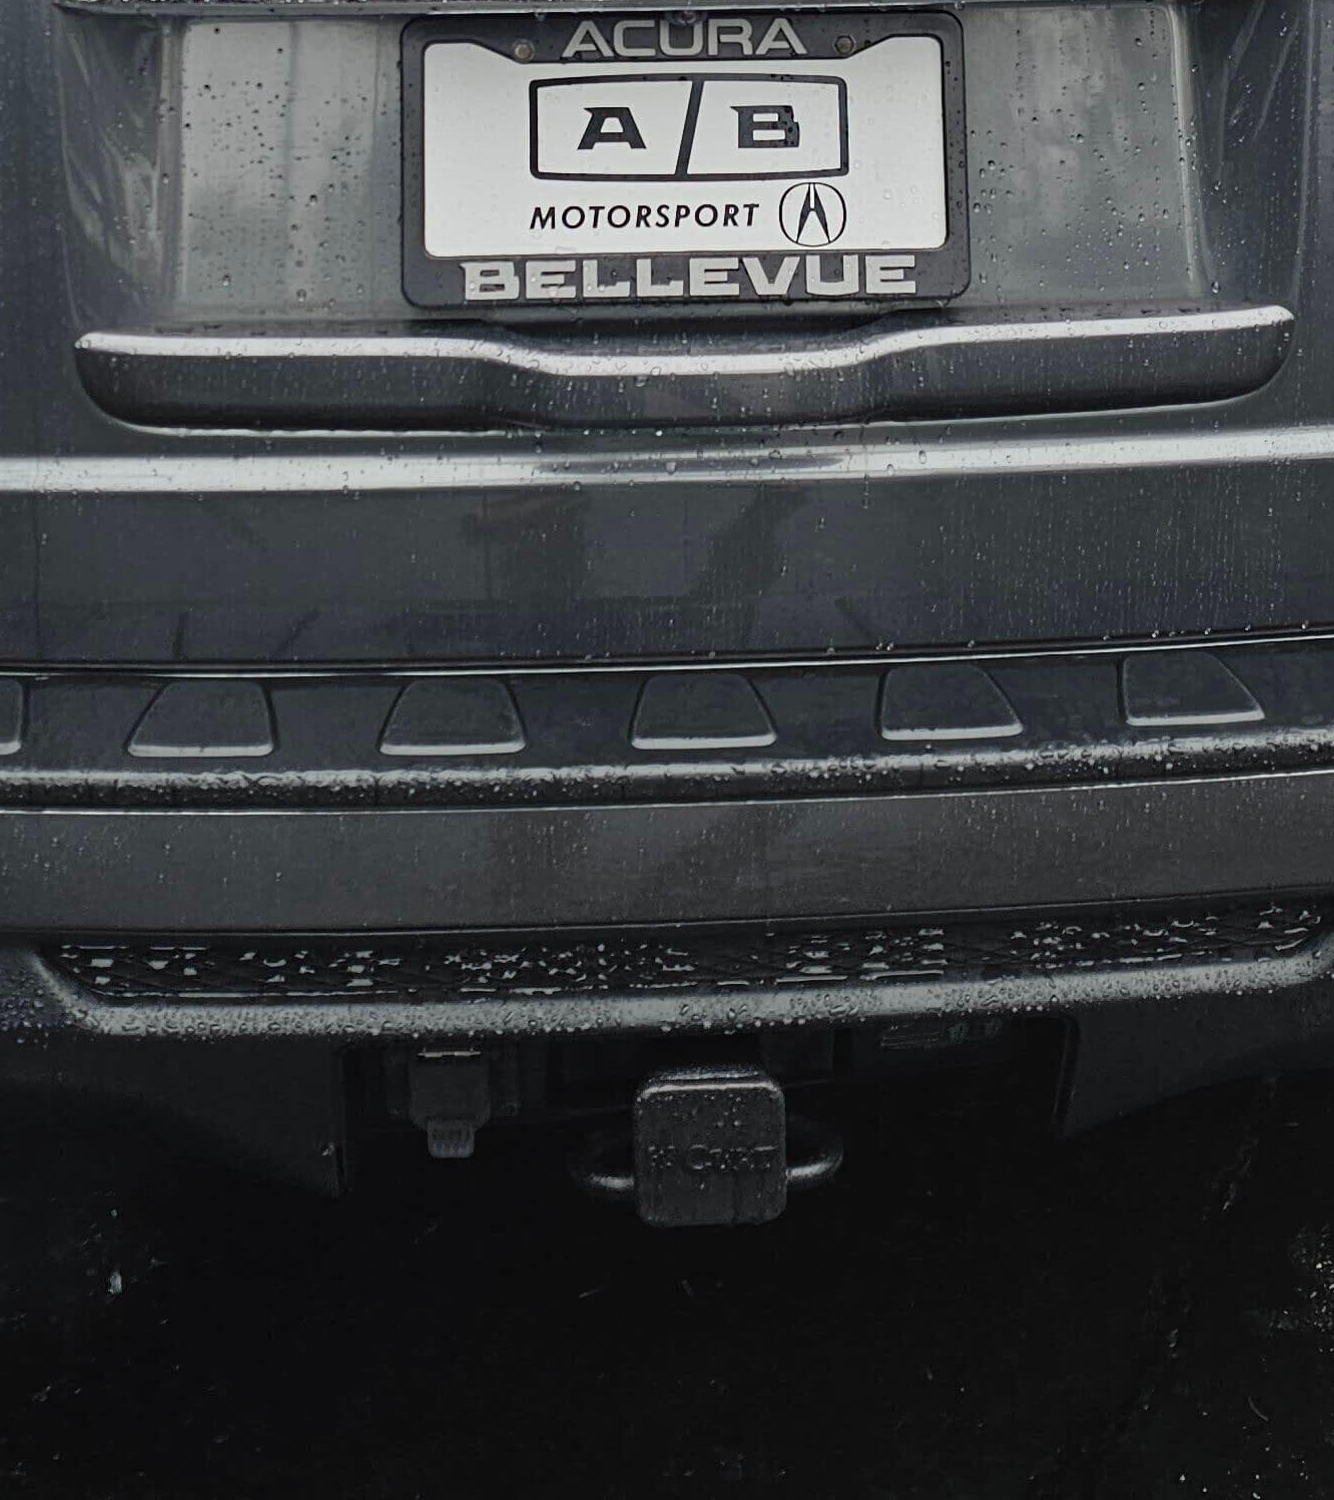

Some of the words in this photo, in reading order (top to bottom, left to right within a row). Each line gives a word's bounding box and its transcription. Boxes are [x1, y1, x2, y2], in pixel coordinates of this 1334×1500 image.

[562, 18, 807, 58] ACURA
[530, 204, 759, 229] MOTORSPORT
[461, 255, 916, 300] BELLEVUE
